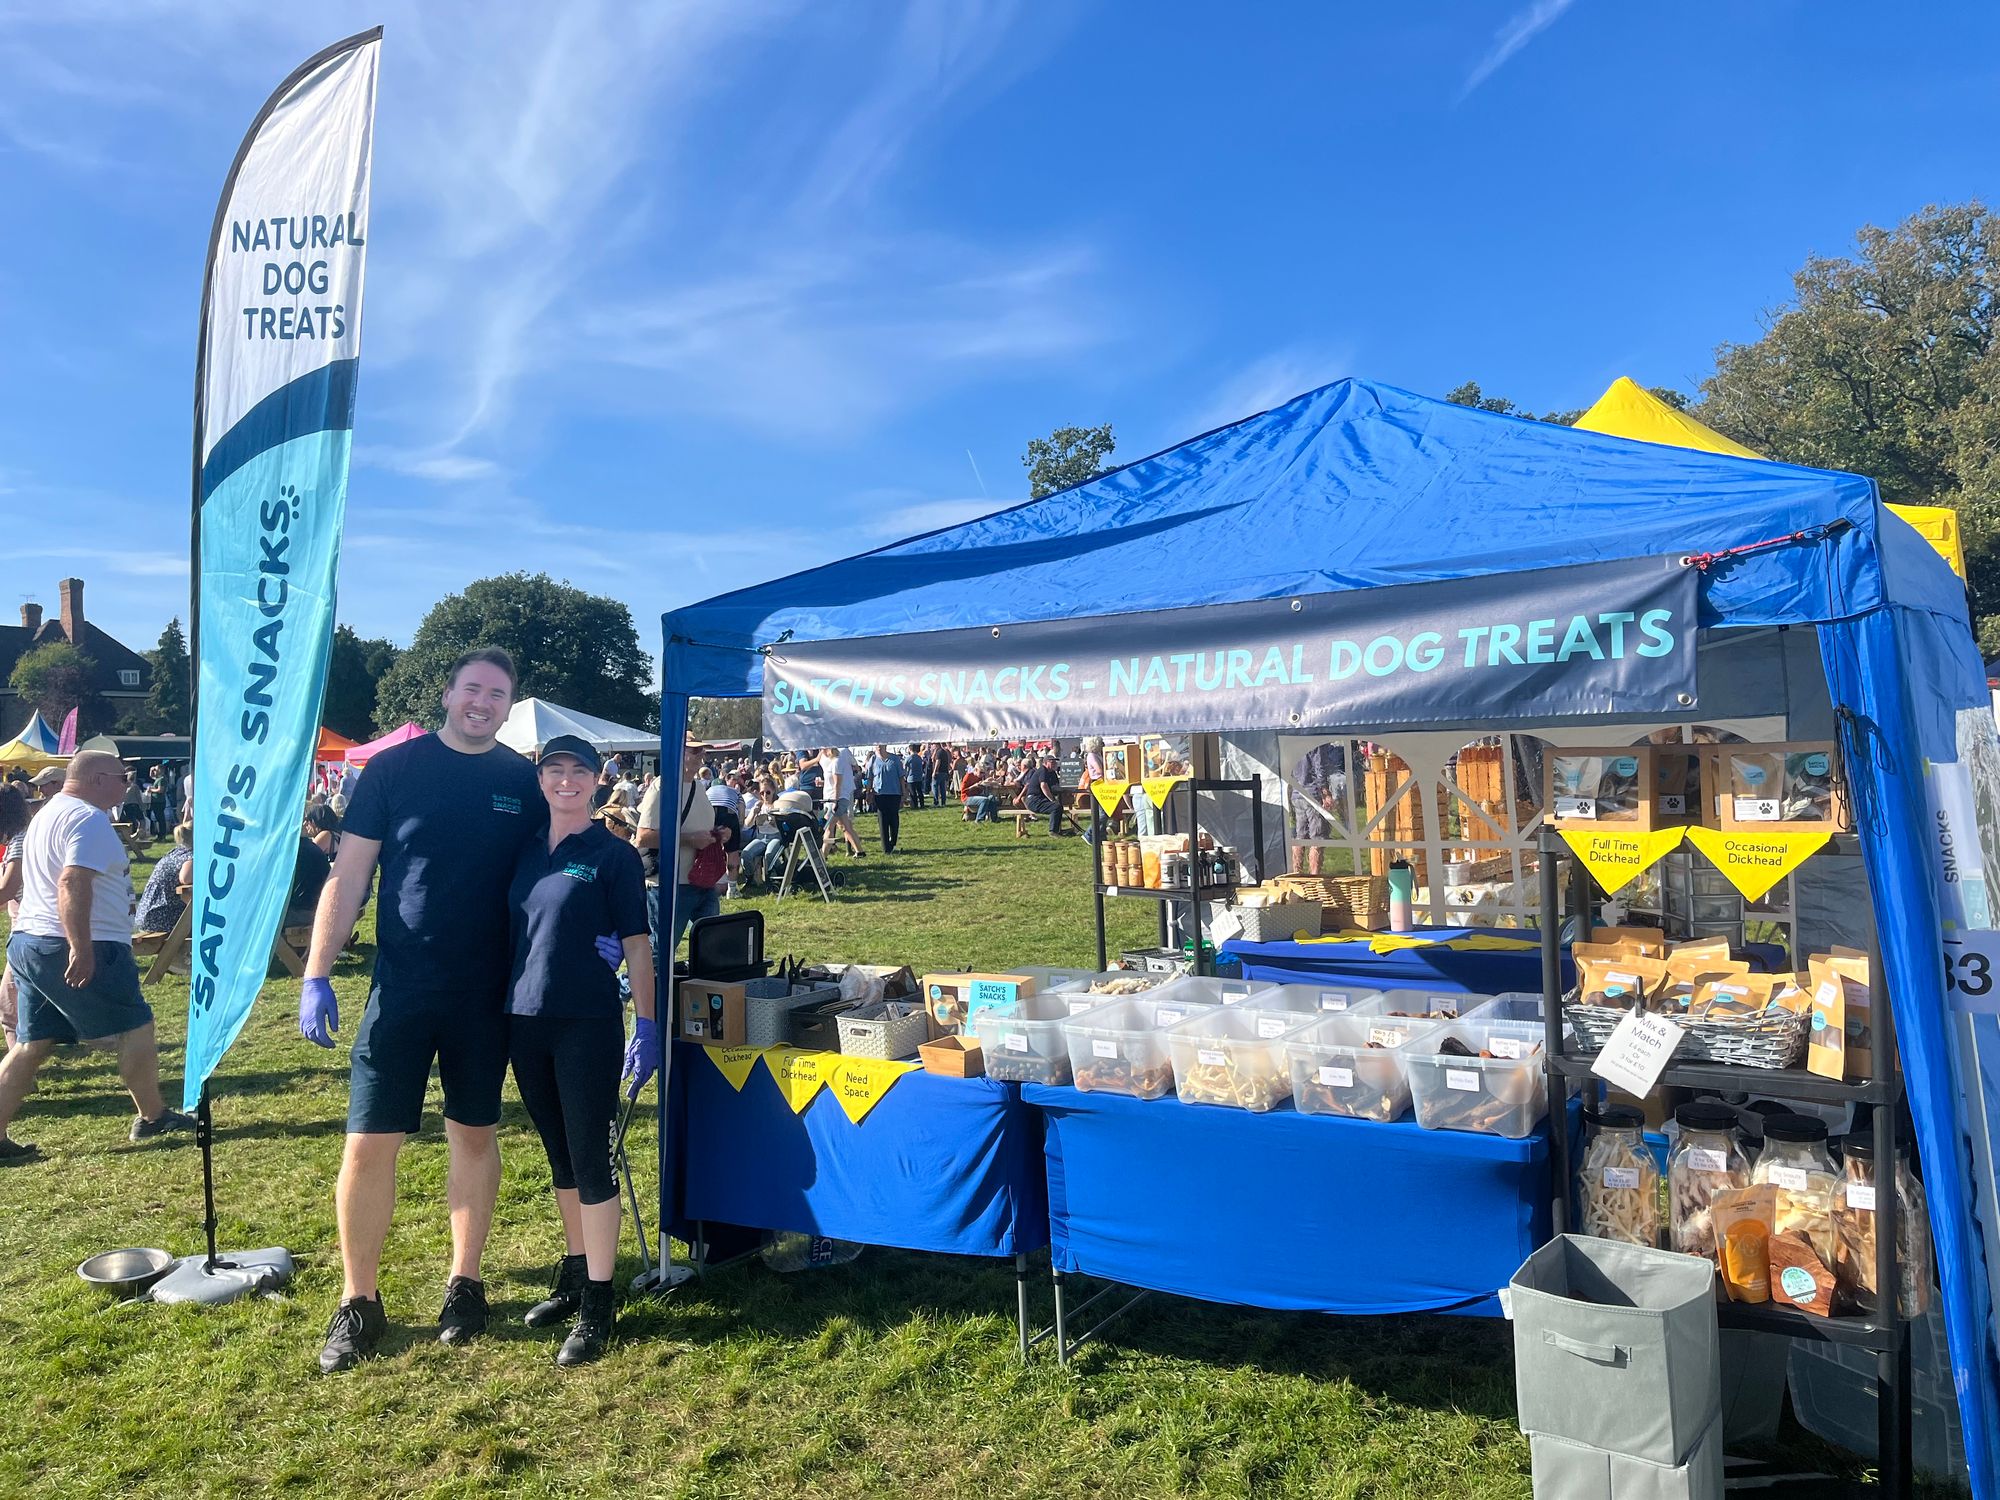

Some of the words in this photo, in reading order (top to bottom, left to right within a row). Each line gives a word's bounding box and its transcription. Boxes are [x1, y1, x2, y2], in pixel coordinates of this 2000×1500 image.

[232, 211, 365, 253] NATURAL
[263, 260, 328, 295] DOG
[243, 304, 345, 340] TREATS
[772, 674, 904, 715] SATCH'S
[913, 663, 1073, 707] SNACKS
[1108, 643, 1313, 697] NATURAL
[1329, 632, 1445, 681] DOG
[1458, 609, 1676, 668] TREATS
[194, 764, 257, 1012] SATCH'S
[241, 499, 290, 745] SNACKS
[1592, 838, 1611, 851] Full
[1612, 839, 1639, 852] Time
[1724, 840, 1789, 854] Occasional
[1936, 809, 1960, 884] SNACKS
[1589, 851, 1641, 865] Dickhead
[1728, 852, 1783, 867] Dickhead
[979, 984, 1007, 993] SATCH'S
[979, 992, 1006, 1001] SNACKS
[1639, 1017, 1658, 1032] Mix
[1657, 1027, 1668, 1037] &
[1631, 1026, 1663, 1049] Match
[723, 1052, 753, 1064] Dickhead
[781, 1068, 817, 1082] Dickhead
[846, 1072, 868, 1085] Need
[844, 1085, 870, 1098] Space
